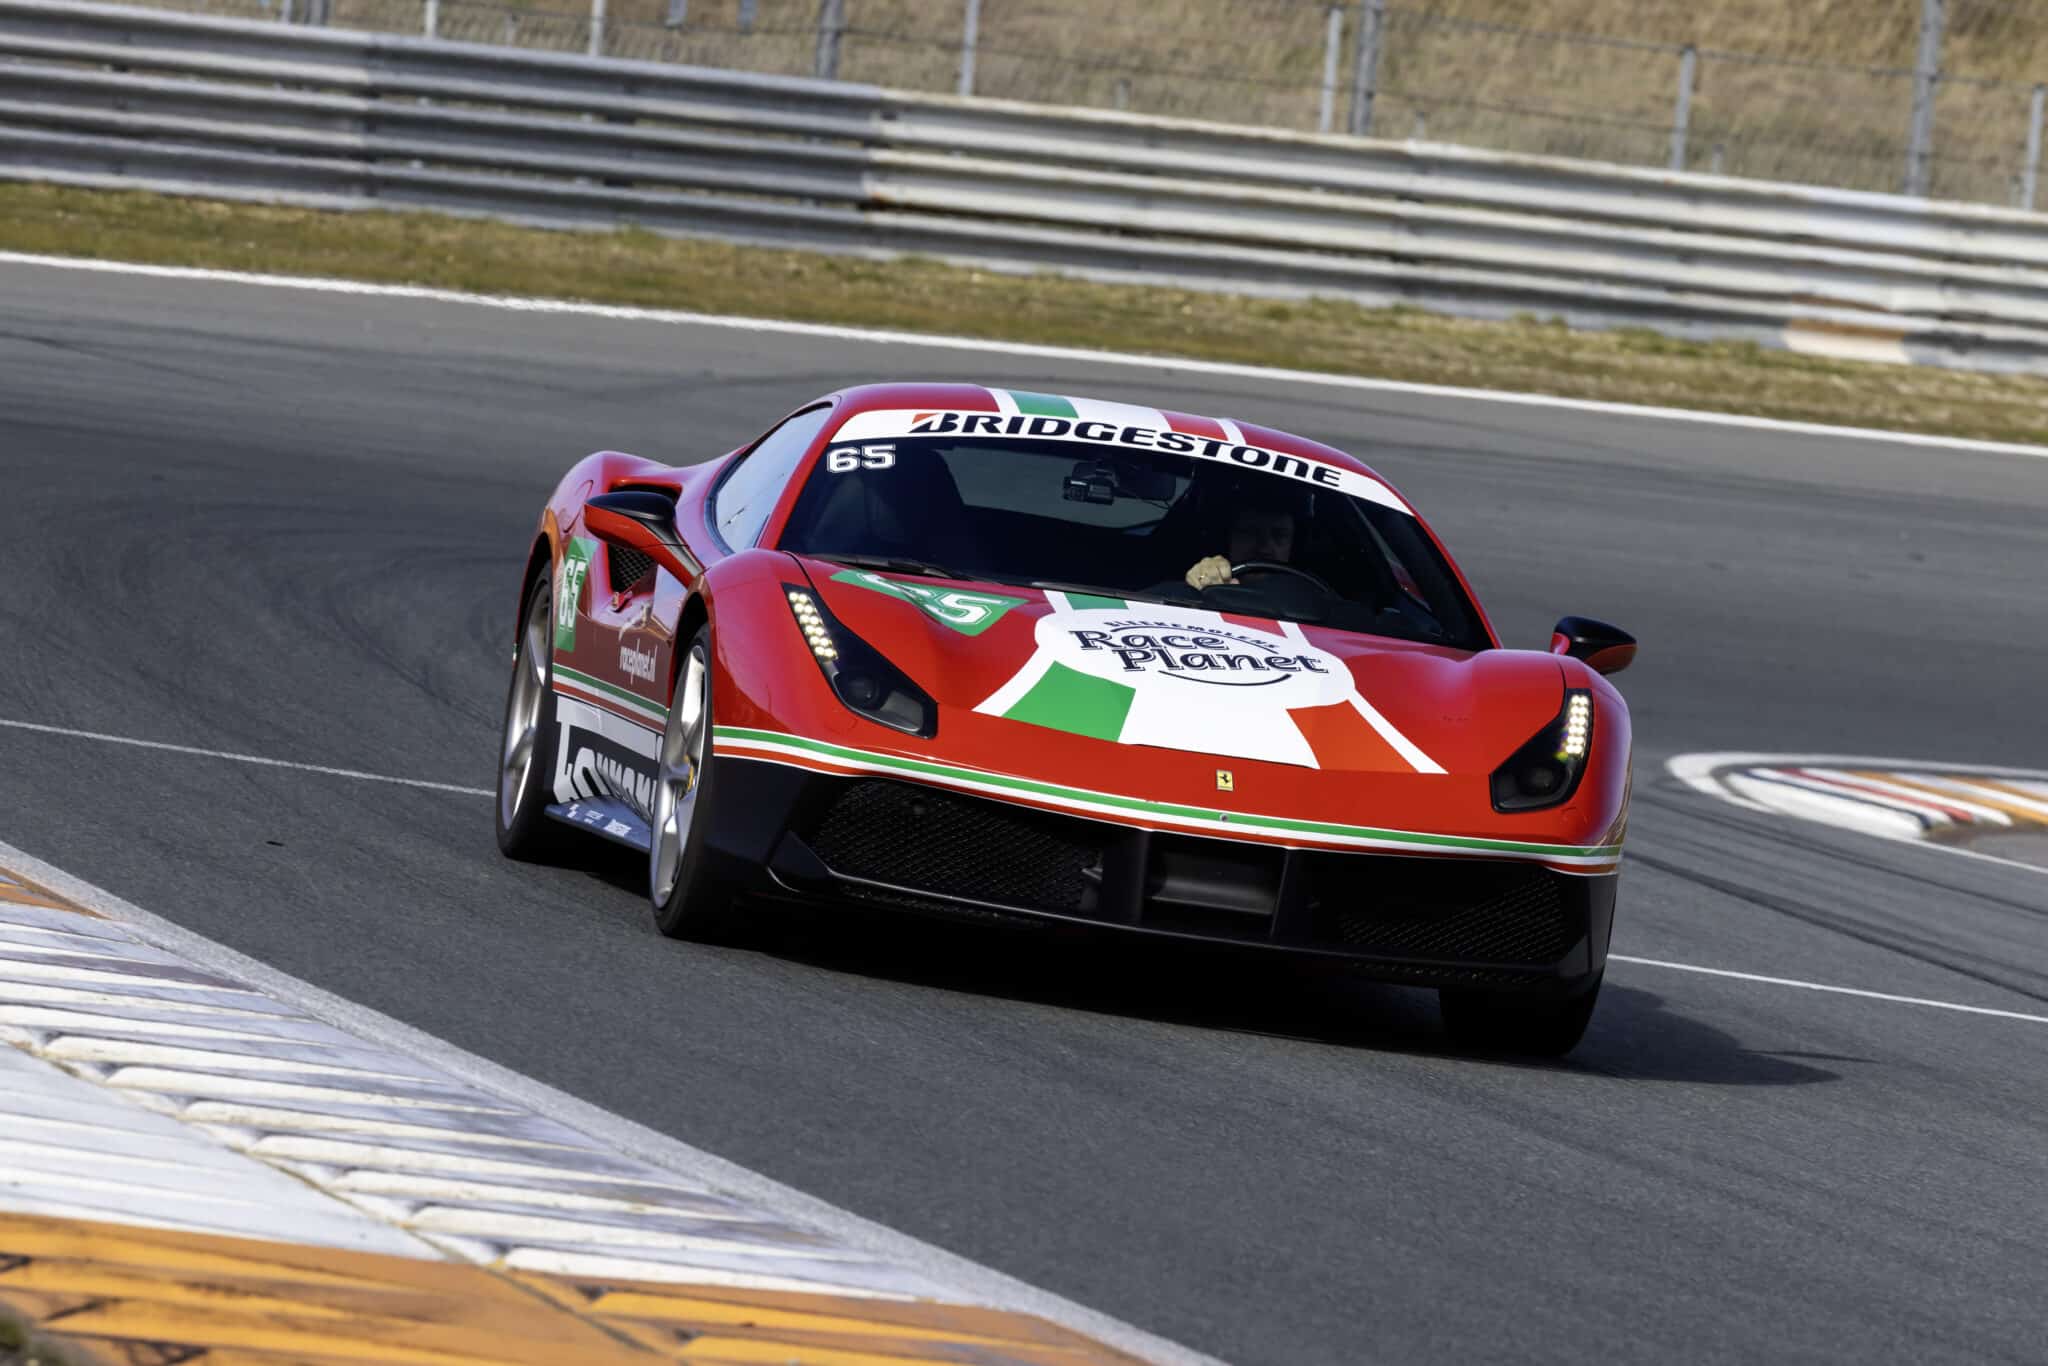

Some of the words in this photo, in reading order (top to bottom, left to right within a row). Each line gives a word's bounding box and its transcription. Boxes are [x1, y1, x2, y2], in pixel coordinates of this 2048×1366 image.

[826, 443, 897, 474] 65
[908, 412, 1343, 488] BRIDGESTONE
[559, 554, 588, 633] 65
[1068, 629, 1230, 651] Race
[1111, 647, 1329, 675] Planet
